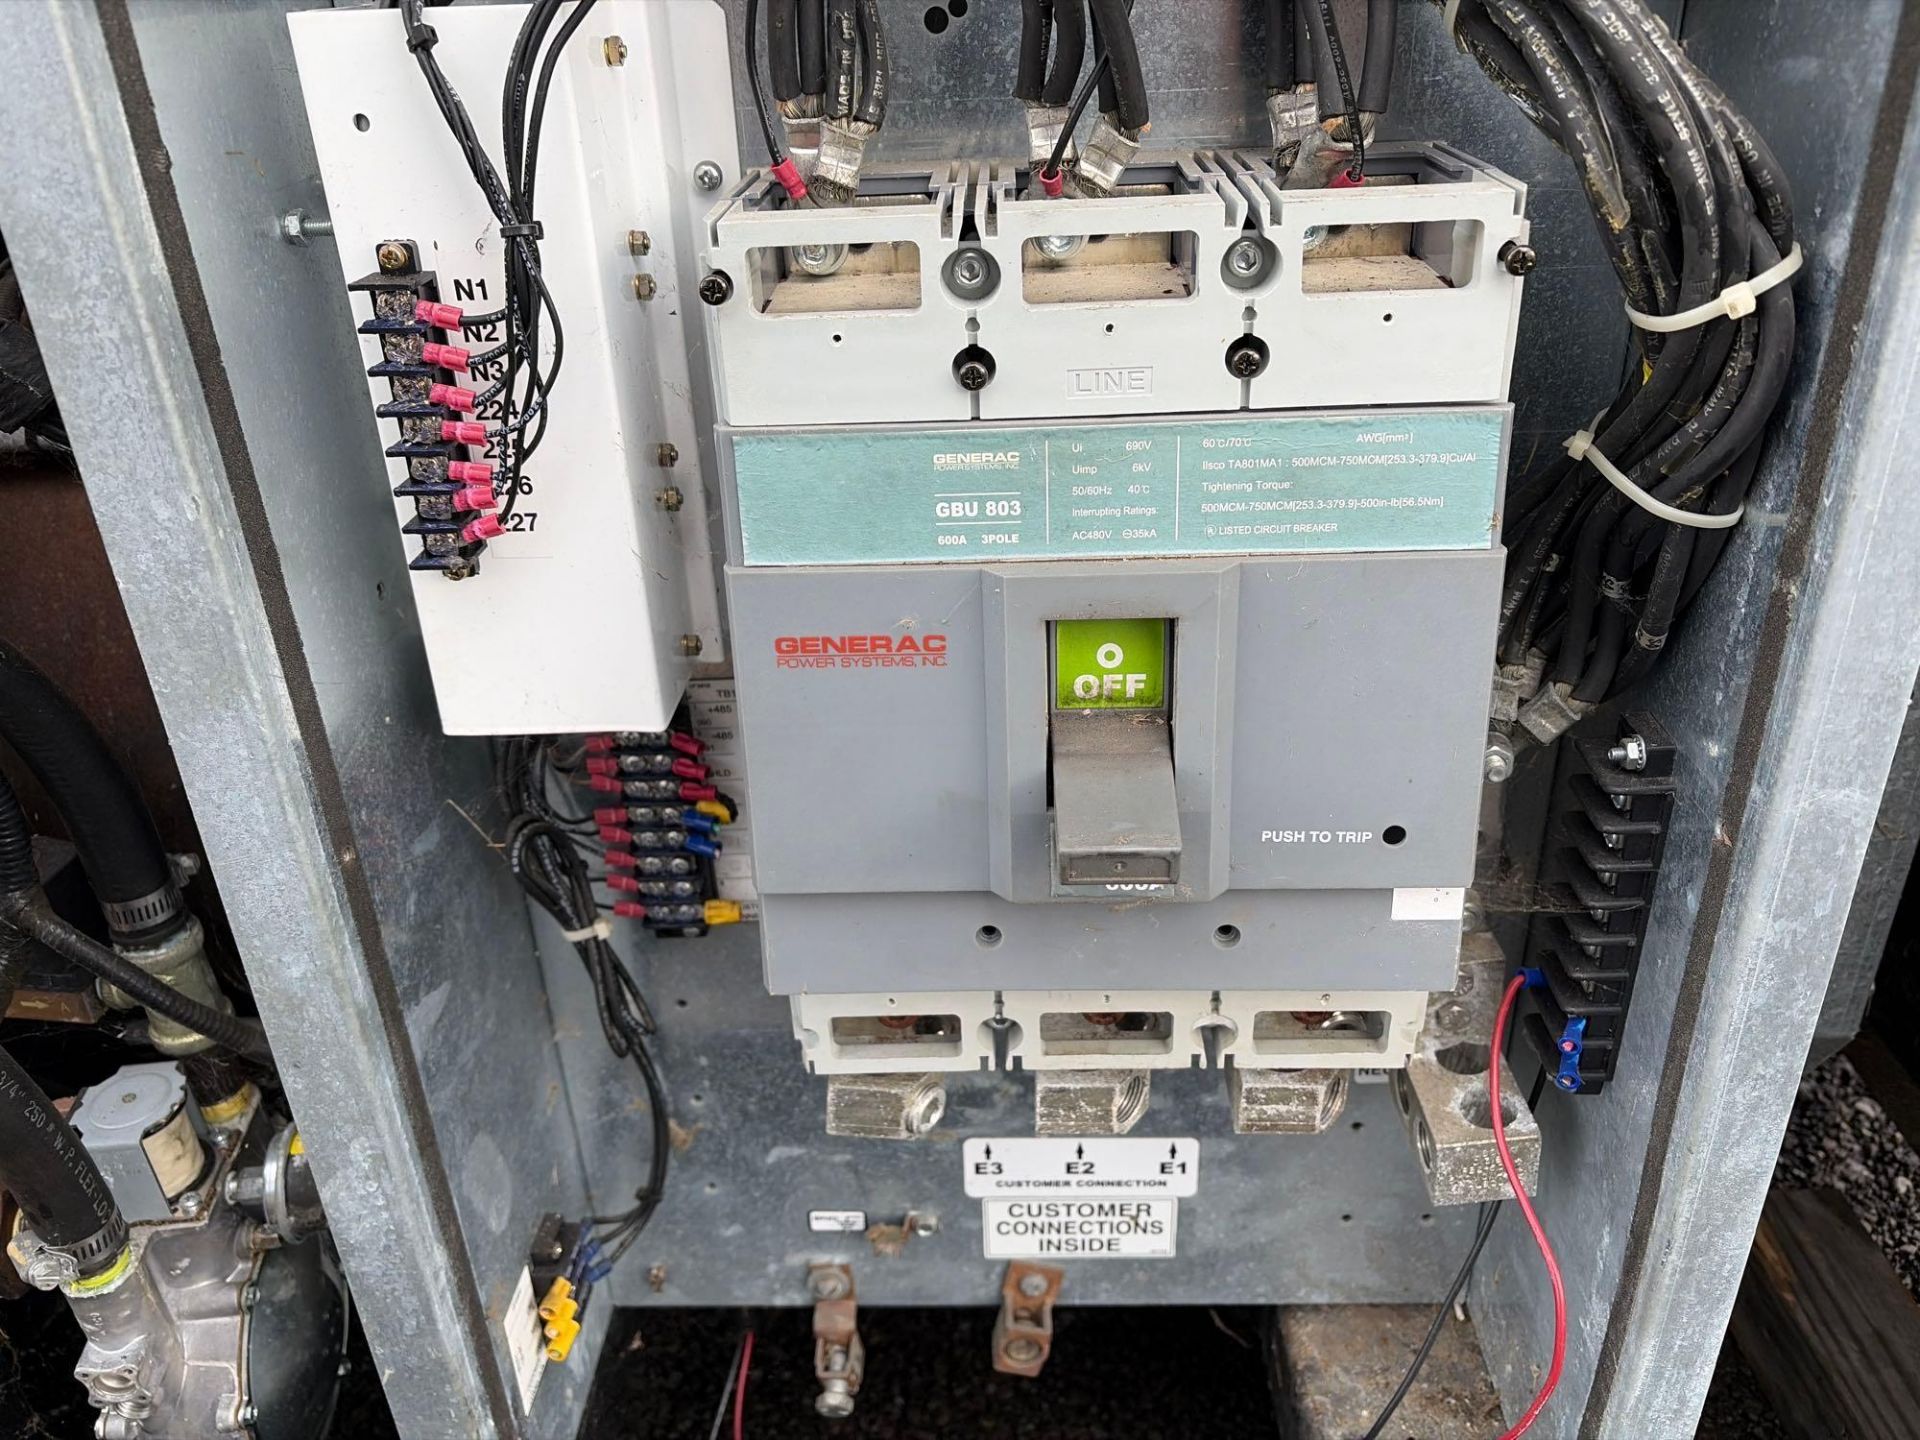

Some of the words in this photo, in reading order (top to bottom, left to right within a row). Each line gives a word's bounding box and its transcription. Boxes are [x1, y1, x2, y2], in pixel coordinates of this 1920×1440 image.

[453, 278, 488, 301] N1
[463, 323, 500, 343] N2
[471, 361, 505, 382] N3
[1075, 370, 1146, 392] LINE
[1125, 441, 1152, 451] 690V
[933, 452, 1020, 464] GENERAC
[1072, 464, 1098, 476] Uimp
[1132, 462, 1152, 473] 6kV
[1201, 481, 1253, 493] Tightening
[1255, 480, 1294, 491] Torque:
[935, 502, 979, 518] GBU
[985, 500, 1021, 516] 803
[1072, 507, 1121, 518] Interrupting
[1123, 505, 1159, 517] Ratings:
[1072, 530, 1113, 541] AC480V
[1218, 525, 1252, 535] LISTED
[1253, 524, 1291, 534] CIRCUIT
[1293, 523, 1338, 533] BREAKER
[937, 535, 967, 545] 600A
[981, 533, 1019, 544] 3POLE
[774, 634, 948, 654] GENERAC
[776, 656, 835, 669] POWER
[840, 656, 917, 669] SYSTEMS,
[1073, 673, 1147, 699] OFF
[1261, 830, 1306, 843] PUSH
[1309, 830, 1332, 843] TO
[1336, 831, 1373, 843] TRIP
[24, 1101, 46, 1128] 250
[974, 1162, 1004, 1175] E3
[1065, 1162, 1095, 1175] E2
[1160, 1162, 1188, 1175] E1
[995, 1179, 1072, 1188] CUSTOMER
[1075, 1179, 1168, 1188] CONNECTION
[1008, 1203, 1153, 1219] CUSTOMER
[996, 1220, 1164, 1236] CONNECTIONS
[1039, 1238, 1121, 1252] INSIDE
